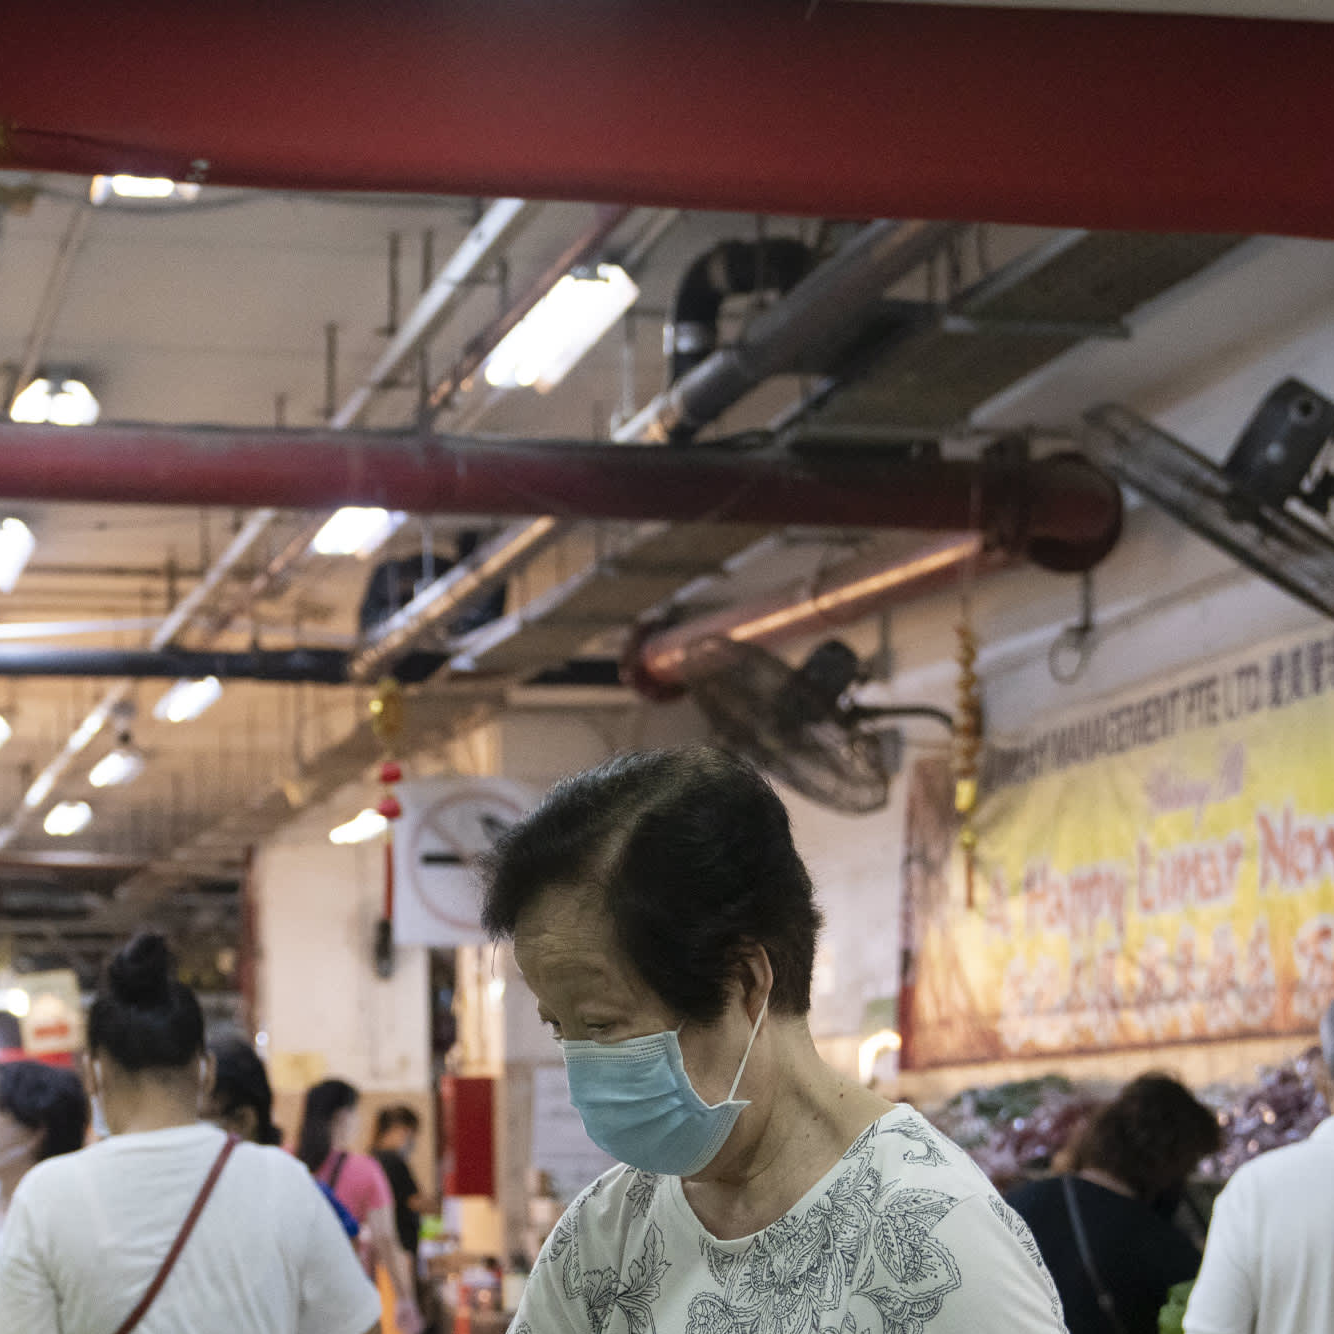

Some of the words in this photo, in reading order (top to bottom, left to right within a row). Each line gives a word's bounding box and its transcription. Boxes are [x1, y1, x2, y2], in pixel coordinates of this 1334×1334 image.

[1049, 686, 1181, 767] MANAGEMENT
[1024, 860, 1125, 942] Happy
[1136, 831, 1244, 917] Lunar
